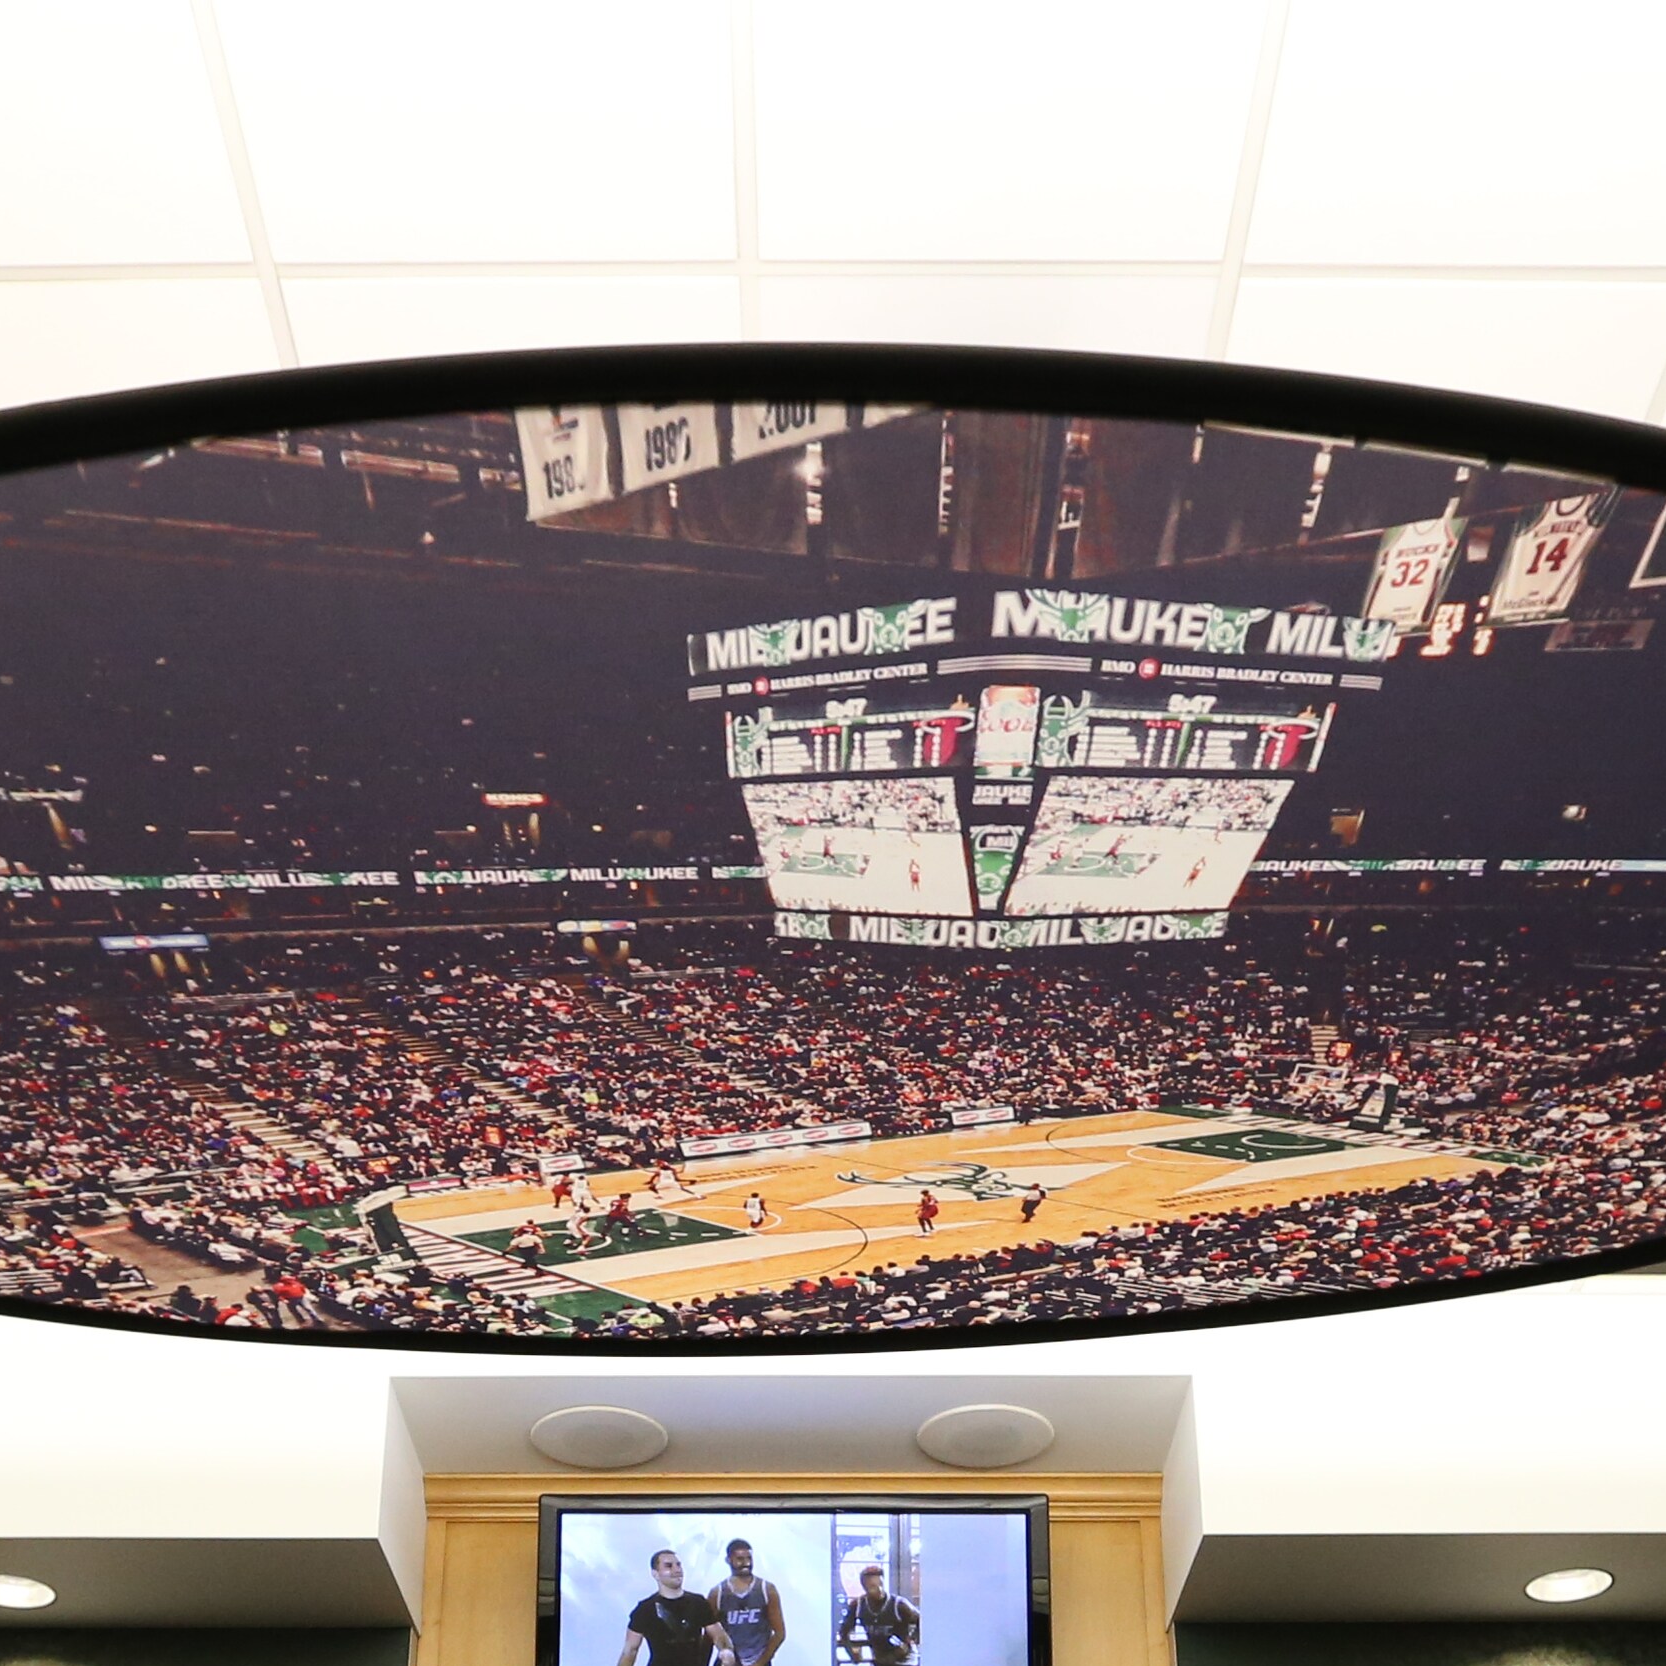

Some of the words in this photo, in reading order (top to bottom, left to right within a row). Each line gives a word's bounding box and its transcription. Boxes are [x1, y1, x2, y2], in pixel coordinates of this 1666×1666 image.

[543, 455, 585, 498] 198
[1526, 537, 1570, 575] 14
[1391, 558, 1430, 589] 32
[873, 662, 928, 681] CENTER
[1101, 659, 1136, 674] BMO
[1160, 662, 1215, 679] HARRIS
[1216, 666, 1279, 683] BRADLEY
[1280, 670, 1334, 686] CENTER
[727, 1608, 761, 1625] UFC
